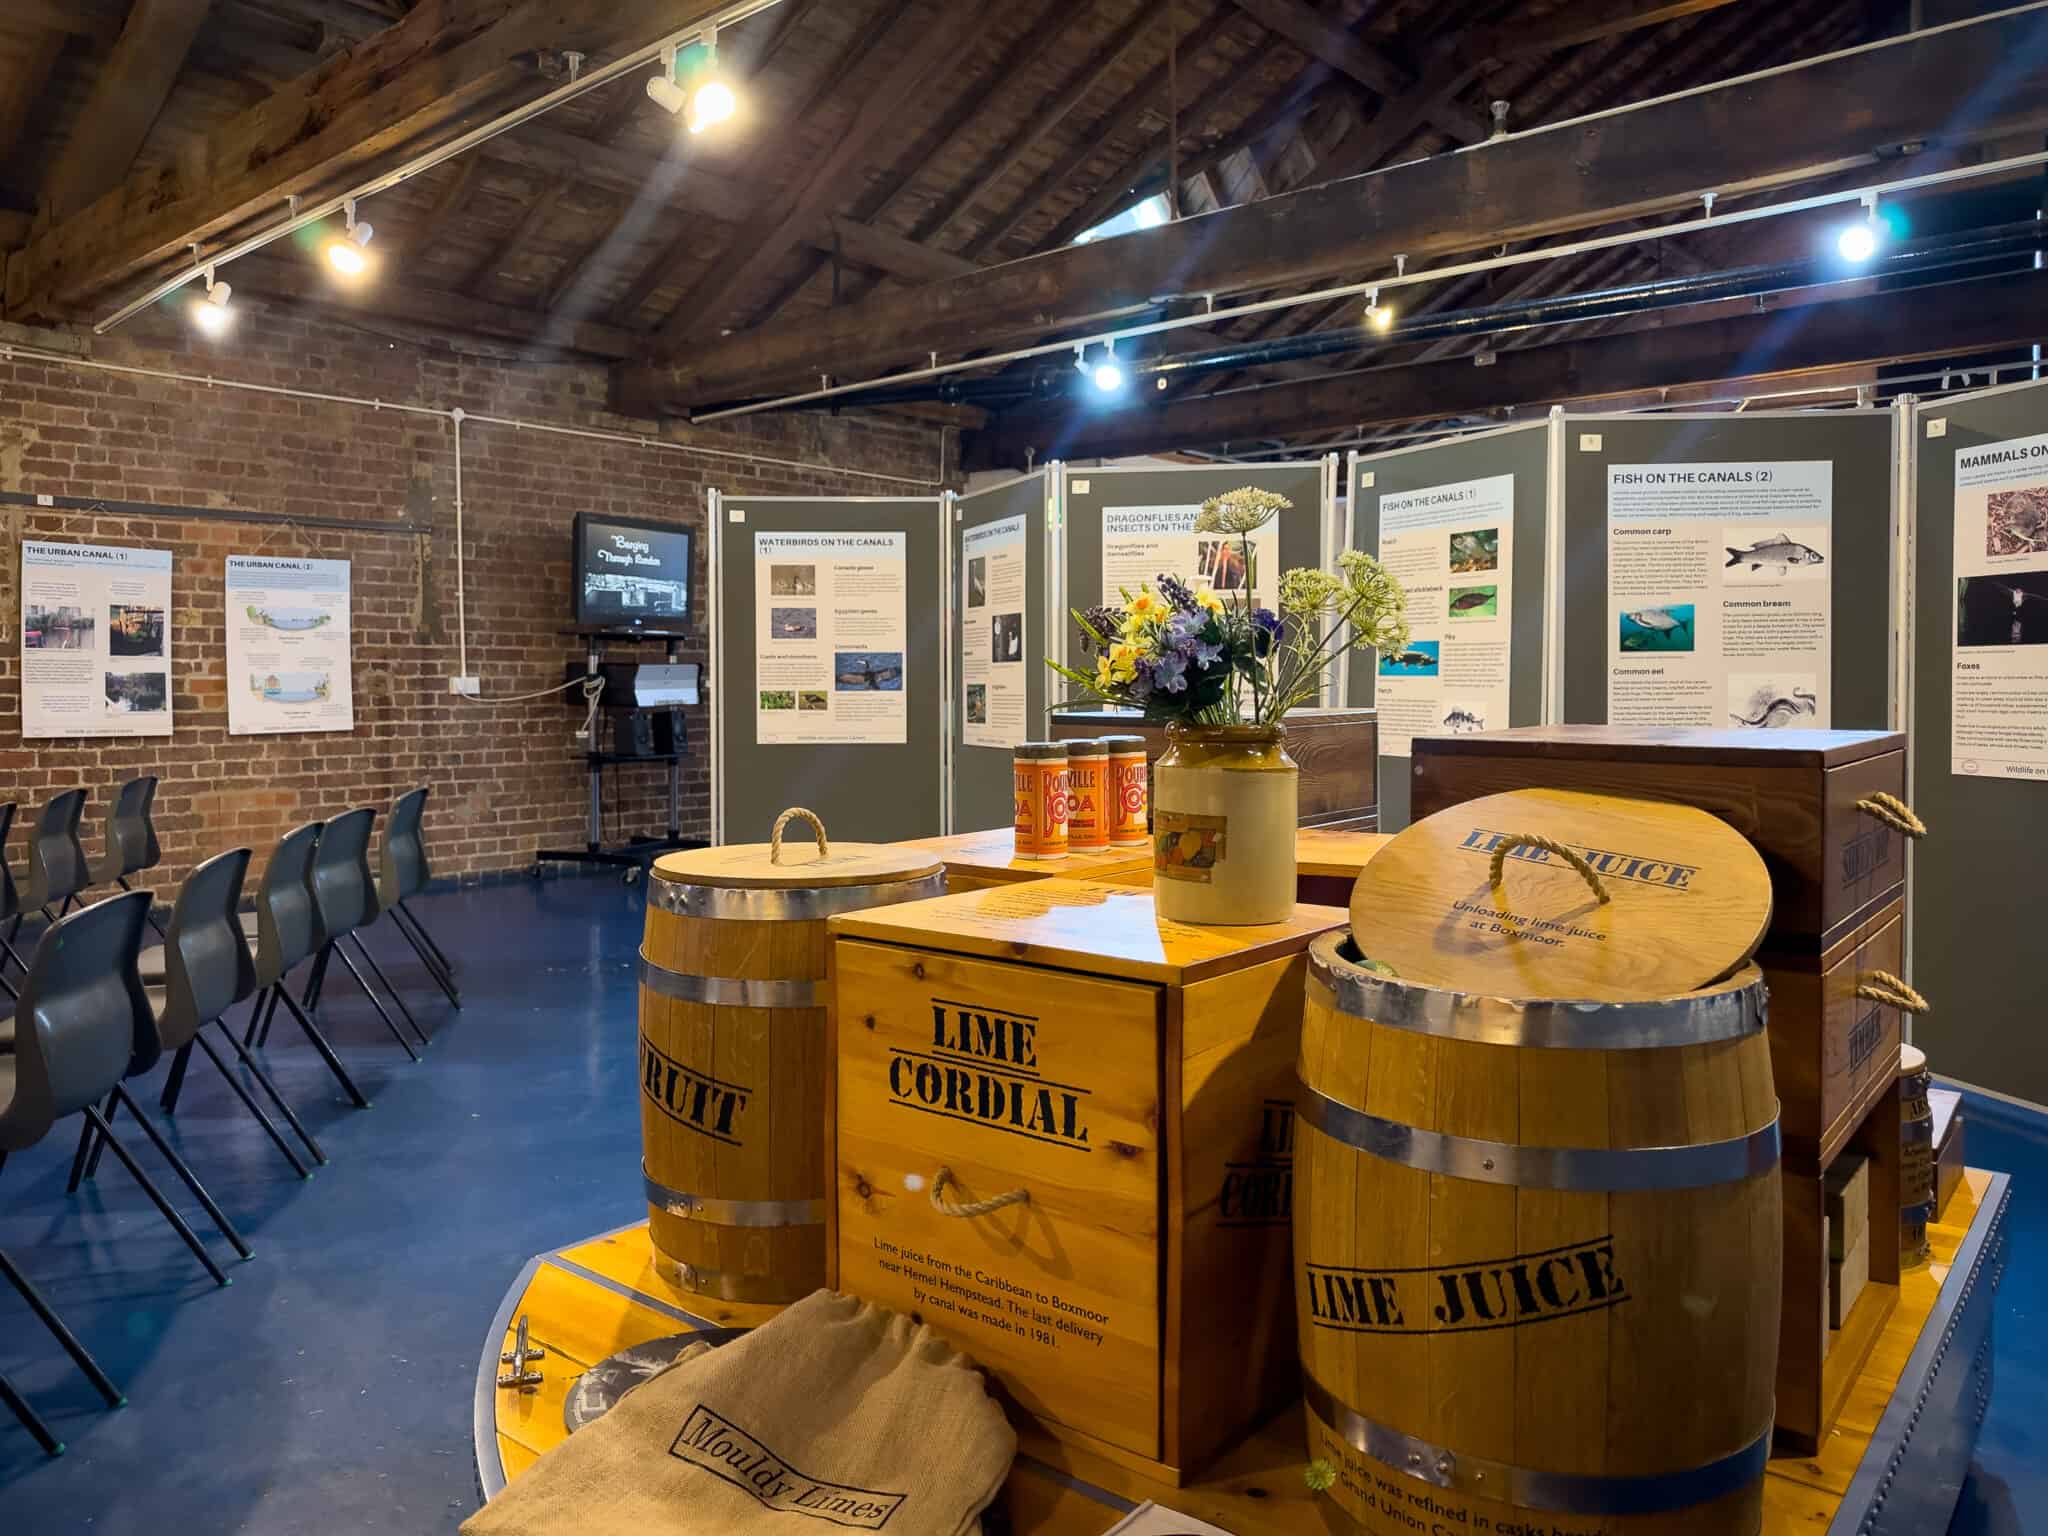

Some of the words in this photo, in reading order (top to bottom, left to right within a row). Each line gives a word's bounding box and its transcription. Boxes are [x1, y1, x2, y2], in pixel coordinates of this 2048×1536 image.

[1960, 448, 2028, 469] MAMMALS
[1614, 474, 1643, 484] FISH
[1646, 473, 1666, 484] ON
[1668, 473, 1695, 483] THE
[1697, 472, 1753, 483] CANALS
[1755, 471, 1773, 483] (2)
[1382, 503, 1399, 512] FISH
[1401, 501, 1414, 510] ON
[1415, 498, 1430, 507] THE
[1431, 492, 1464, 505] CANALS
[1465, 488, 1477, 499] (1)
[1107, 513, 1181, 523] DRAGONFLIES
[1183, 512, 1199, 521] AN
[1107, 524, 1151, 533] INSECTS
[1152, 523, 1169, 532] ON
[1172, 523, 1192, 531] THE
[759, 538, 819, 547] WATERBIRDS
[857, 538, 894, 547] CANALS
[1613, 528, 1651, 536] Common
[1652, 528, 1672, 537] carp
[27, 546, 46, 554] THE
[48, 547, 80, 557] URBAN
[82, 550, 114, 559] CANAL
[115, 552, 128, 561] (1)
[230, 560, 245, 568] THE
[247, 561, 274, 569] URBAN
[275, 562, 302, 570] CANAL
[1723, 600, 1762, 608] Common
[1613, 667, 1650, 675] Common
[1957, 662, 1980, 670] Foxes
[2006, 765, 2034, 774] Wildlife
[1459, 829, 1550, 862] LIE
[1453, 900, 1528, 927] Unloading
[1530, 916, 1565, 932] lime
[1568, 925, 1607, 942] juice
[1470, 920, 1486, 930] at
[1490, 923, 1566, 948] Boxmoor.
[932, 1006, 1037, 1067] LIME
[889, 1056, 1088, 1143] CORDIAL
[874, 1235, 898, 1255] Lime
[901, 1246, 925, 1264] juice
[927, 1254, 952, 1273] from
[955, 1264, 973, 1280] the
[975, 1271, 1033, 1300] Caribbean
[1036, 1292, 1049, 1305] to
[1051, 1295, 1109, 1325] Boxmoor
[1308, 1271, 1404, 1326] LIME
[1434, 1245, 1625, 1323] JUICE
[879, 1258, 901, 1273] near
[903, 1265, 937, 1288] Hemel
[1007, 1299, 1028, 1318] The
[1032, 1307, 1051, 1326] last
[1055, 1318, 1104, 1347] delivery
[913, 1287, 926, 1304] by
[928, 1294, 956, 1312] canal
[958, 1304, 979, 1320] was
[982, 1311, 1012, 1332] made
[1015, 1322, 1026, 1337] in
[1030, 1328, 1060, 1348] 1981.
[682, 1417, 793, 1499] Mouldy
[790, 1485, 890, 1521] Limes
[1340, 1470, 1376, 1506] Grand
[1379, 1501, 1426, 1530] Union
[1376, 1478, 1403, 1499] was
[1407, 1493, 1467, 1524] refined
[1473, 1514, 1490, 1529] in
